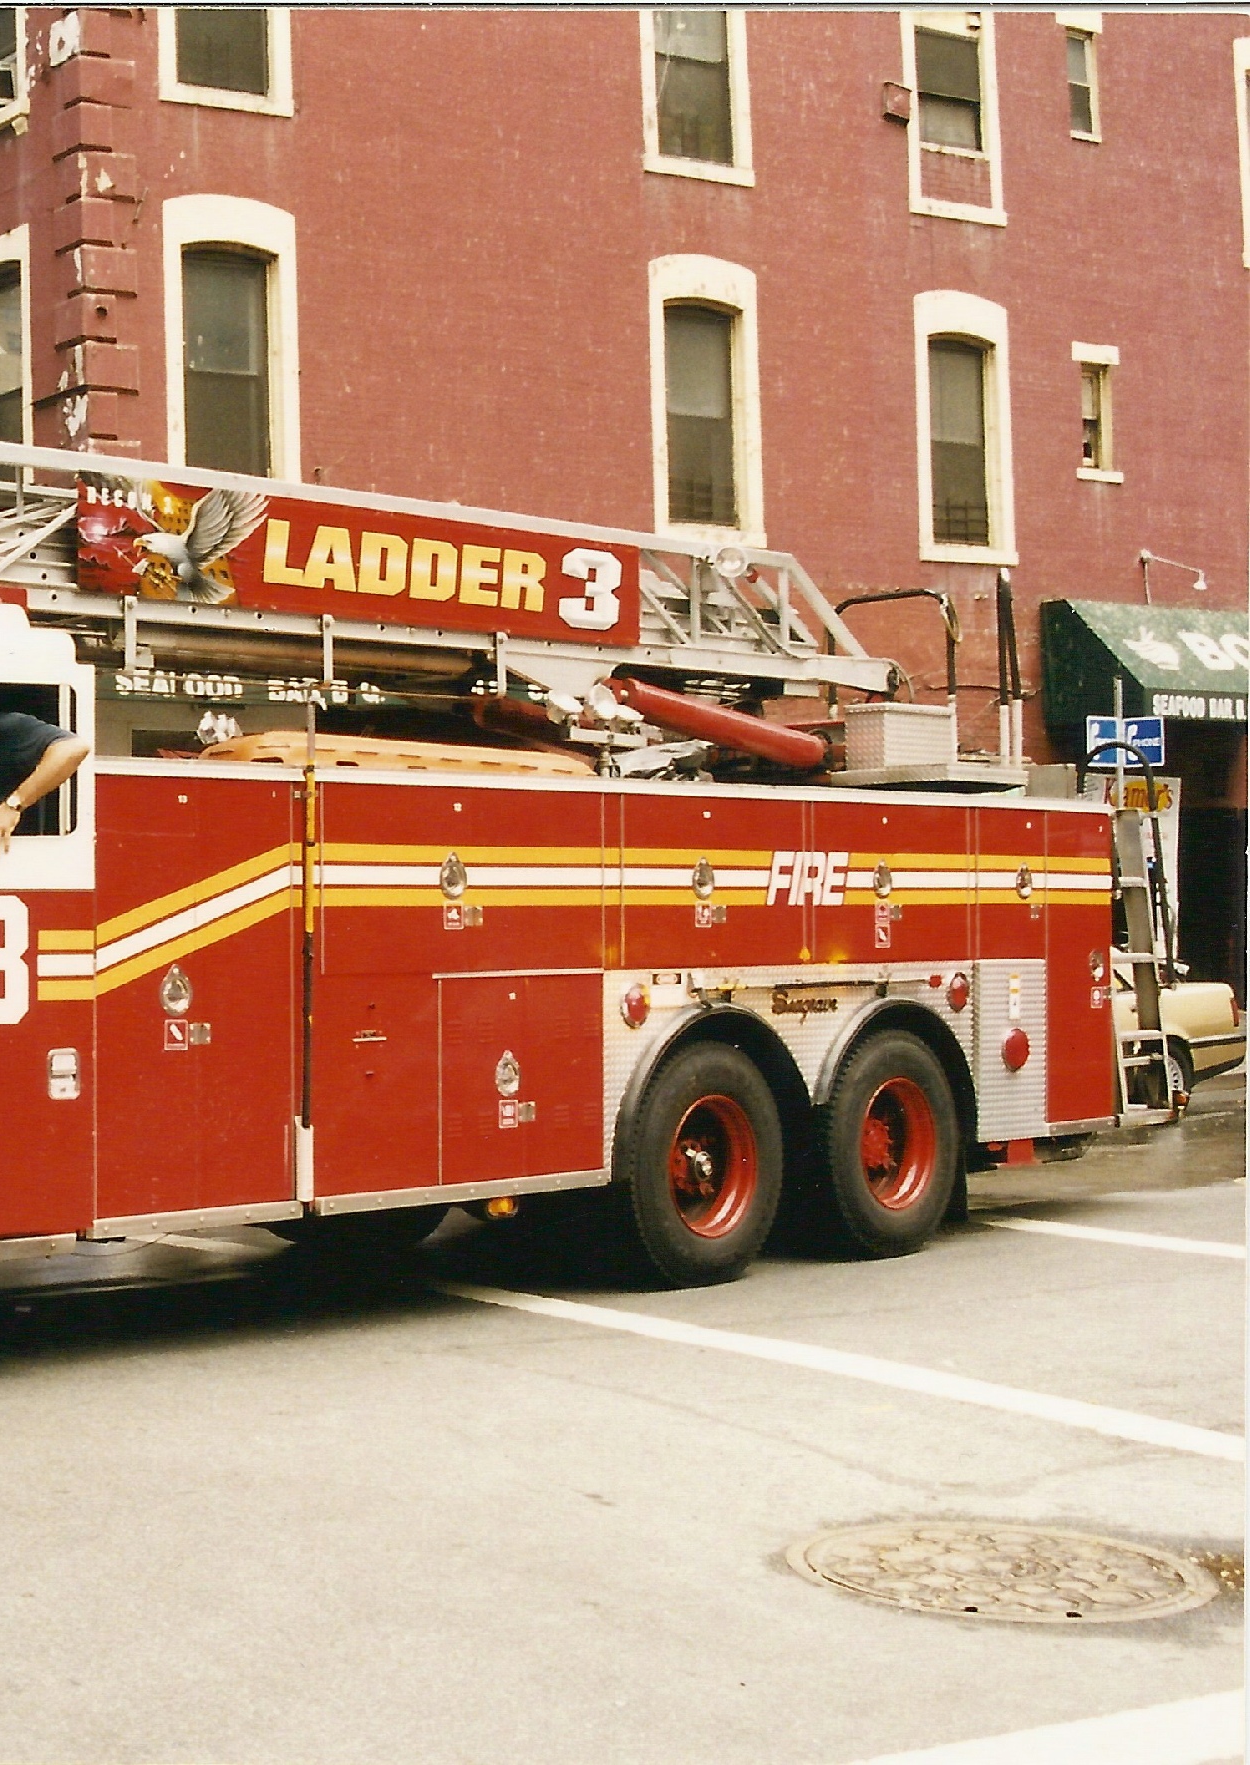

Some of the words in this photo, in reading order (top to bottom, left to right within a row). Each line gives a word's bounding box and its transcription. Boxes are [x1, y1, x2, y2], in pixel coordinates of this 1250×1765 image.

[263, 518, 546, 613] LADDER
[558, 547, 622, 631] 3
[766, 851, 849, 907] FIRE
